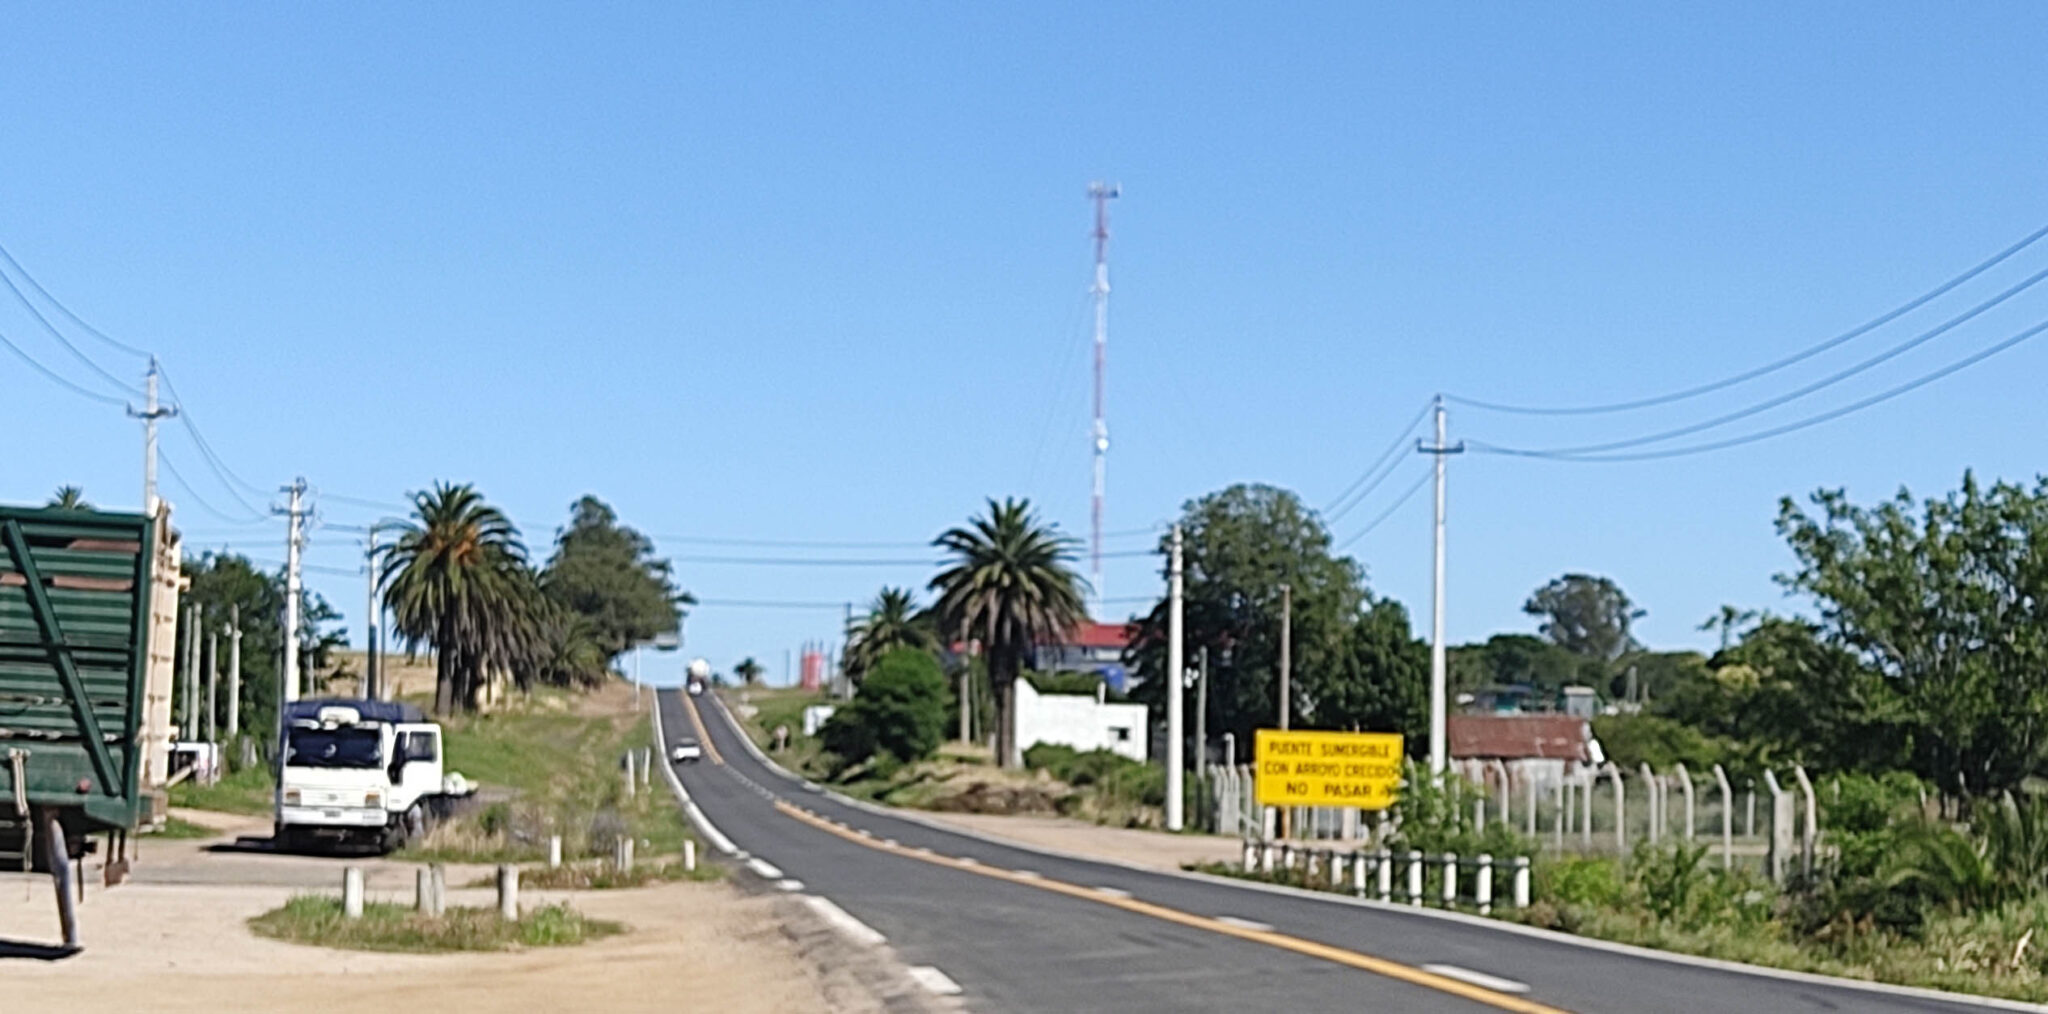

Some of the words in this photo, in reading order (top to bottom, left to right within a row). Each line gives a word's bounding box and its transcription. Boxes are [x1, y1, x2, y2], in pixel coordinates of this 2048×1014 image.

[1269, 741, 1312, 757] PUENTE
[1321, 743, 1390, 758] SUMERGIBLE
[1264, 761, 1289, 776] CON
[1295, 762, 1341, 777] ARROYO
[1345, 763, 1396, 778] CRECIDO
[1286, 781, 1309, 796] NO
[1324, 783, 1372, 798] PASAR
